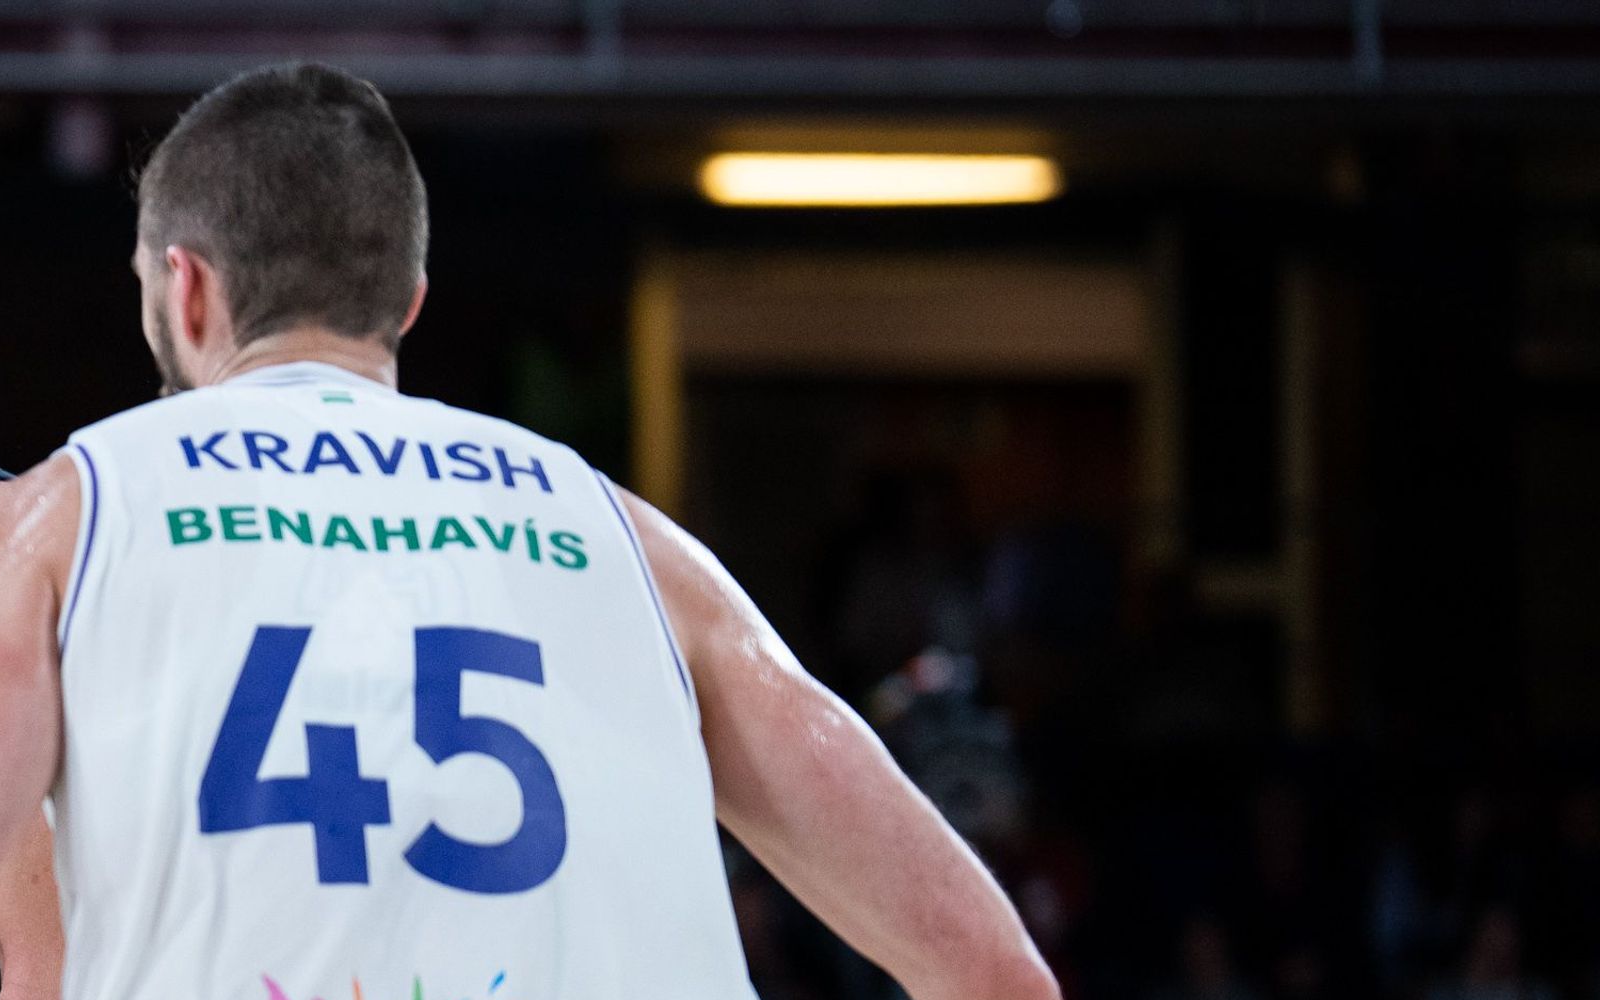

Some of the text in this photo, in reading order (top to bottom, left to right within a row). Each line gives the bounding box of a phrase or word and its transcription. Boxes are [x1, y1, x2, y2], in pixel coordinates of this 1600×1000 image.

[178, 430, 553, 494] KRAVISH
[165, 504, 590, 571] BENAHAVÍS
[197, 625, 568, 896] 45
